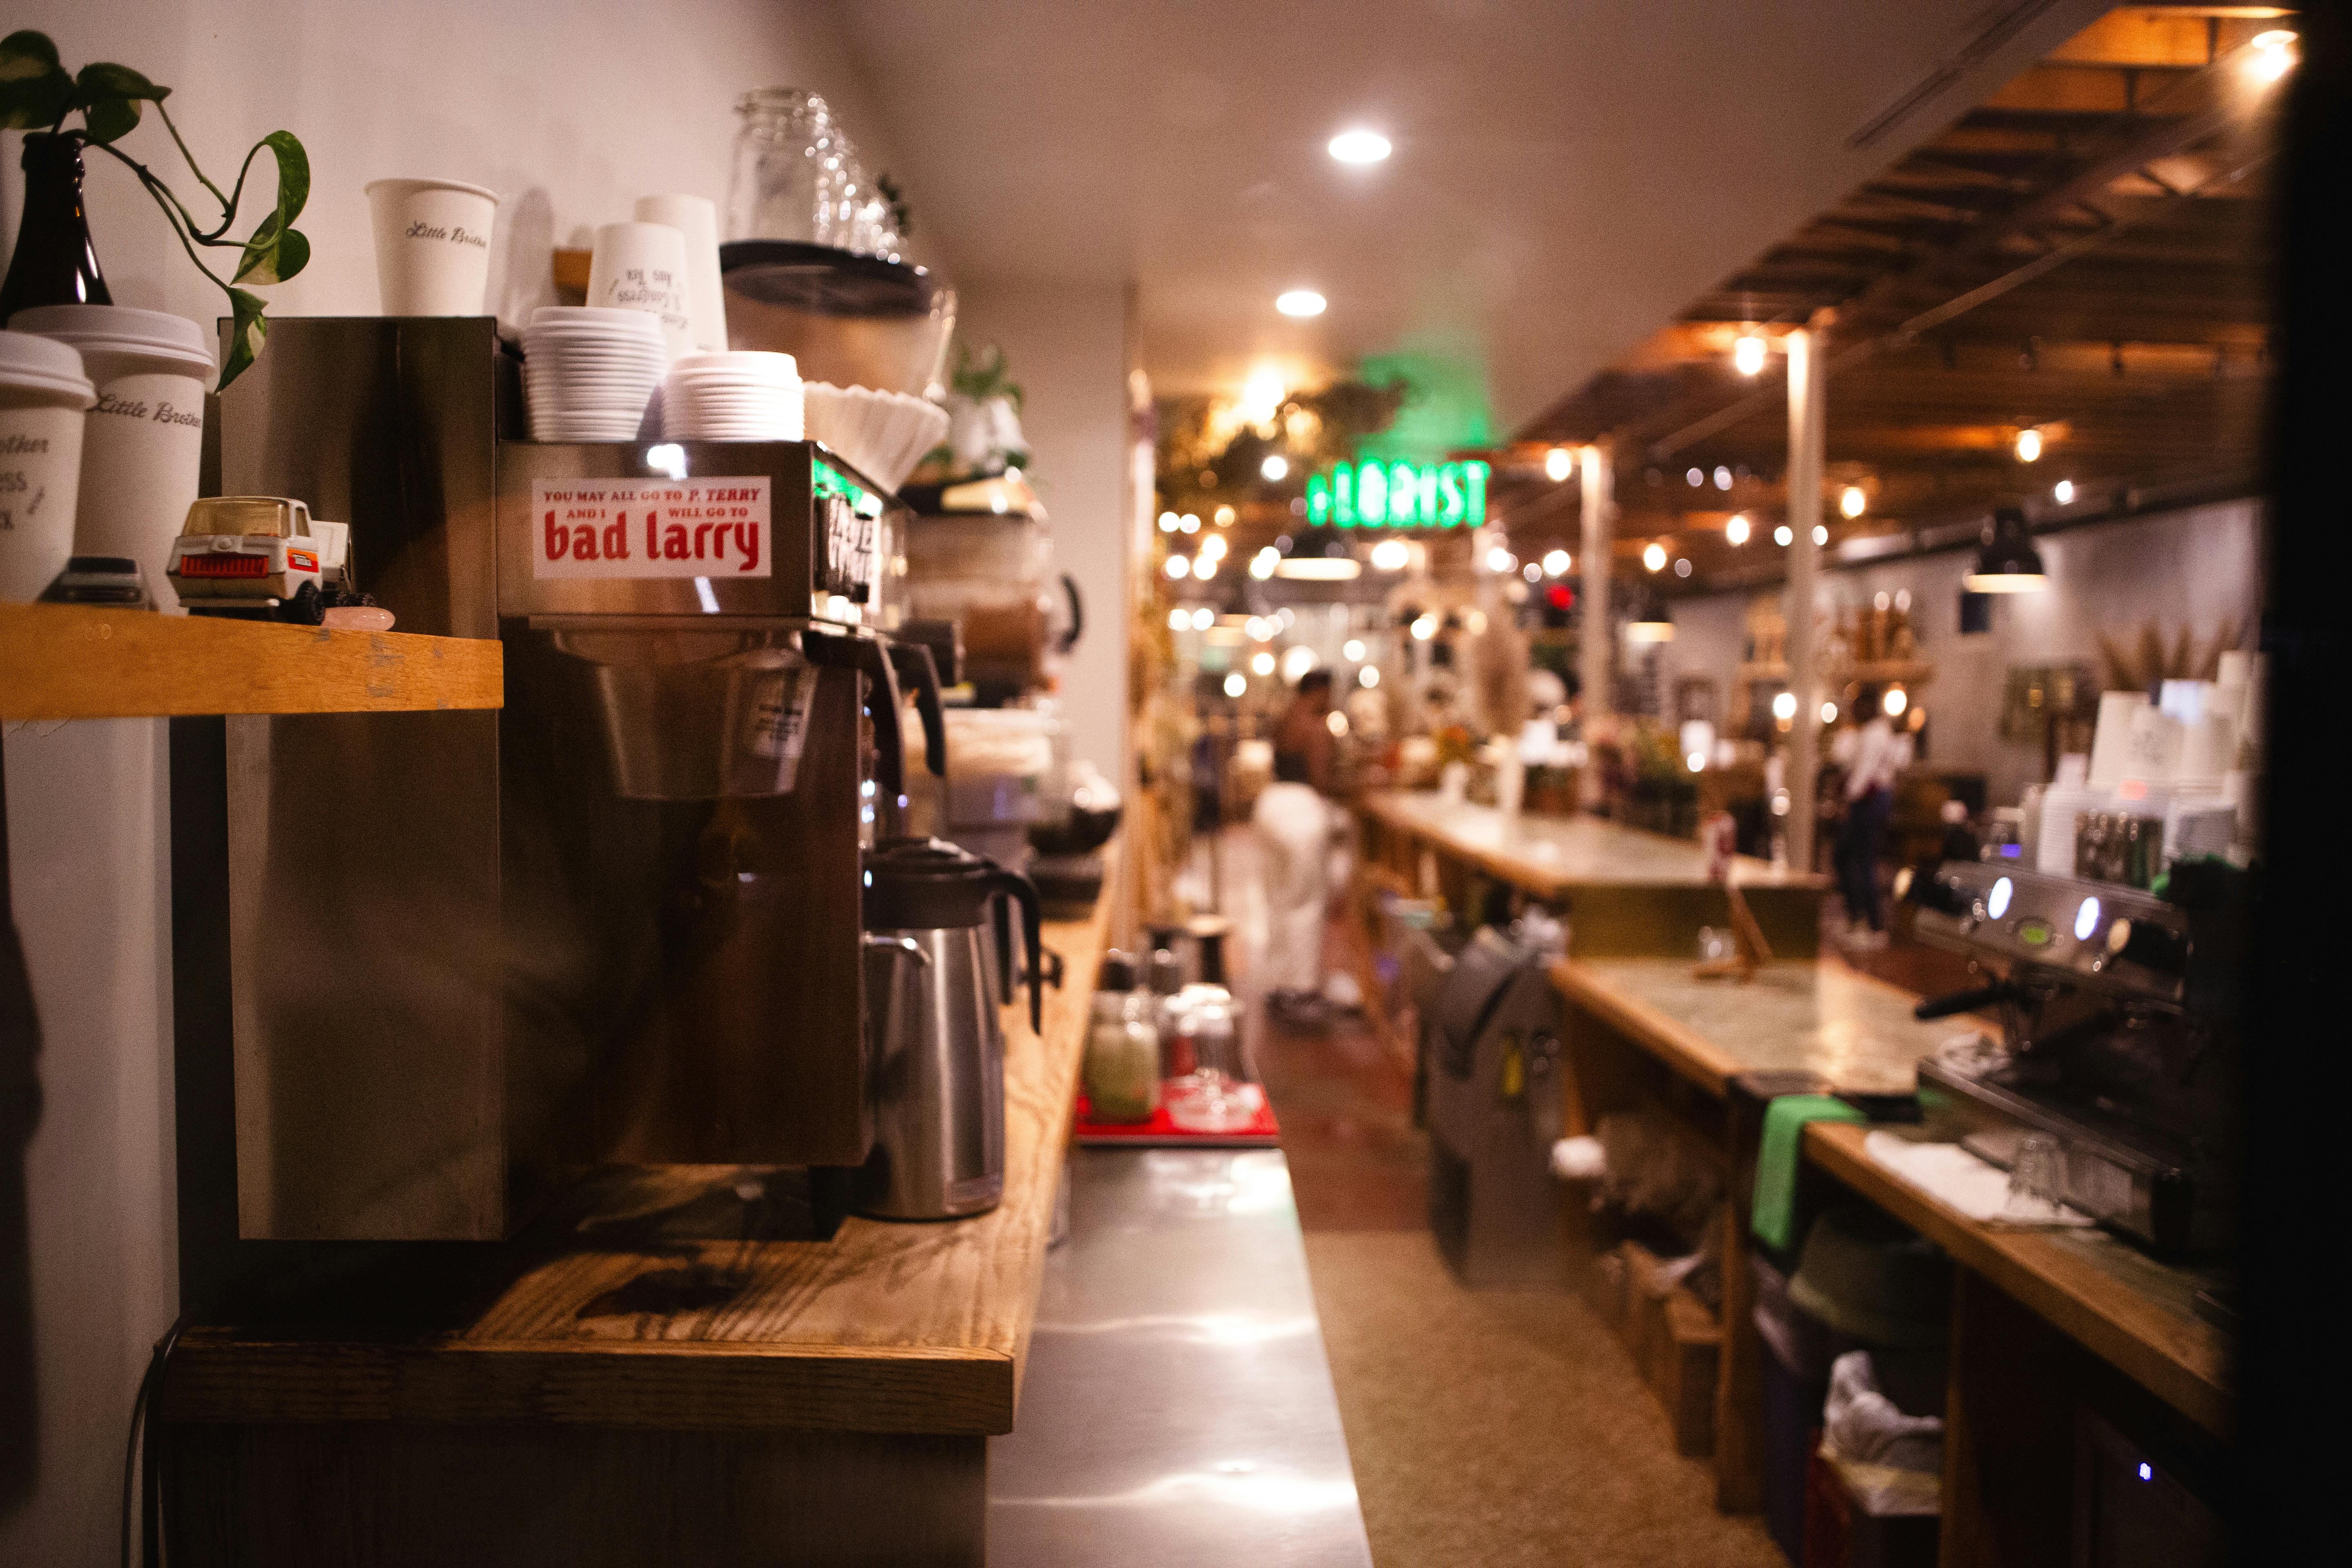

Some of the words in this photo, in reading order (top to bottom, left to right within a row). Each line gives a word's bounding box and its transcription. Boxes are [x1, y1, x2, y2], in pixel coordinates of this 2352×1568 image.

[405, 220, 446, 238] Little
[85, 393, 148, 418] Little
[545, 491, 571, 502] YOU
[577, 491, 606, 502] MAY
[611, 490, 635, 501] ALL
[640, 490, 659, 501] GO
[664, 490, 682, 500] TO
[706, 489, 761, 501] TERRY
[566, 508, 597, 519] AND
[600, 508, 606, 519] I
[668, 507, 702, 518] WILL
[706, 507, 725, 517] GO
[730, 507, 748, 517] TO
[544, 510, 630, 561] bad
[646, 510, 760, 572] larry
